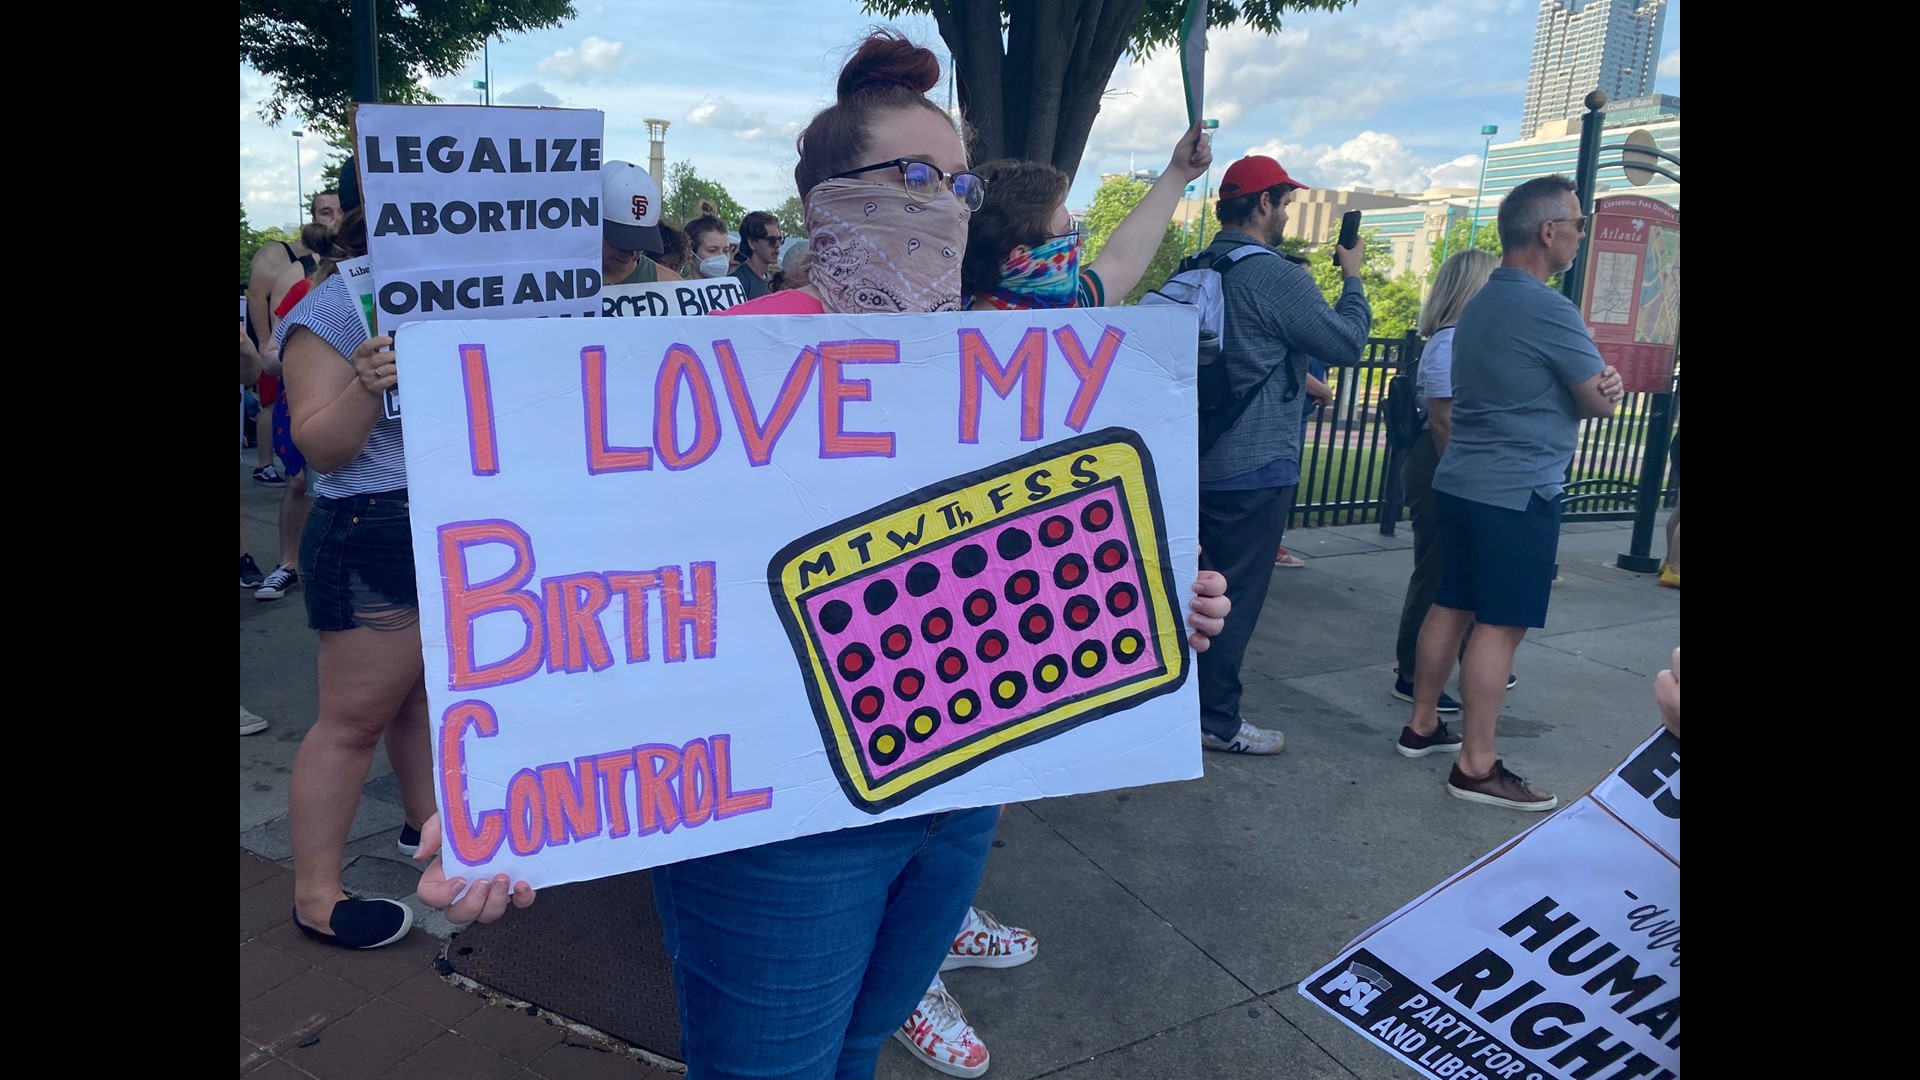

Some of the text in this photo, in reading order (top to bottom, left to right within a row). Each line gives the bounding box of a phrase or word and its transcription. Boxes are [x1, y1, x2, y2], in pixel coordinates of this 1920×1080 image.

[366, 135, 601, 174] LEGALIZE
[373, 197, 599, 237] ABORTION
[1600, 227, 1643, 242] Atlanta
[378, 268, 601, 316] ONCE AND
[675, 283, 748, 317] BIRTH
[459, 324, 1127, 476] I LOVE MY
[798, 551, 837, 591] M
[847, 532, 874, 565] T
[886, 513, 927, 551] W
[987, 483, 1014, 514] F
[1024, 469, 1053, 501] S
[1069, 453, 1101, 488] S
[436, 518, 718, 692] BIRTH
[438, 699, 774, 868] CONTROL
[1321, 968, 1383, 1017] PSL
[1498, 895, 1680, 1051] HUMA
[1369, 1014, 1426, 1053] AND
[1398, 992, 1526, 1079] PARTY FOR
